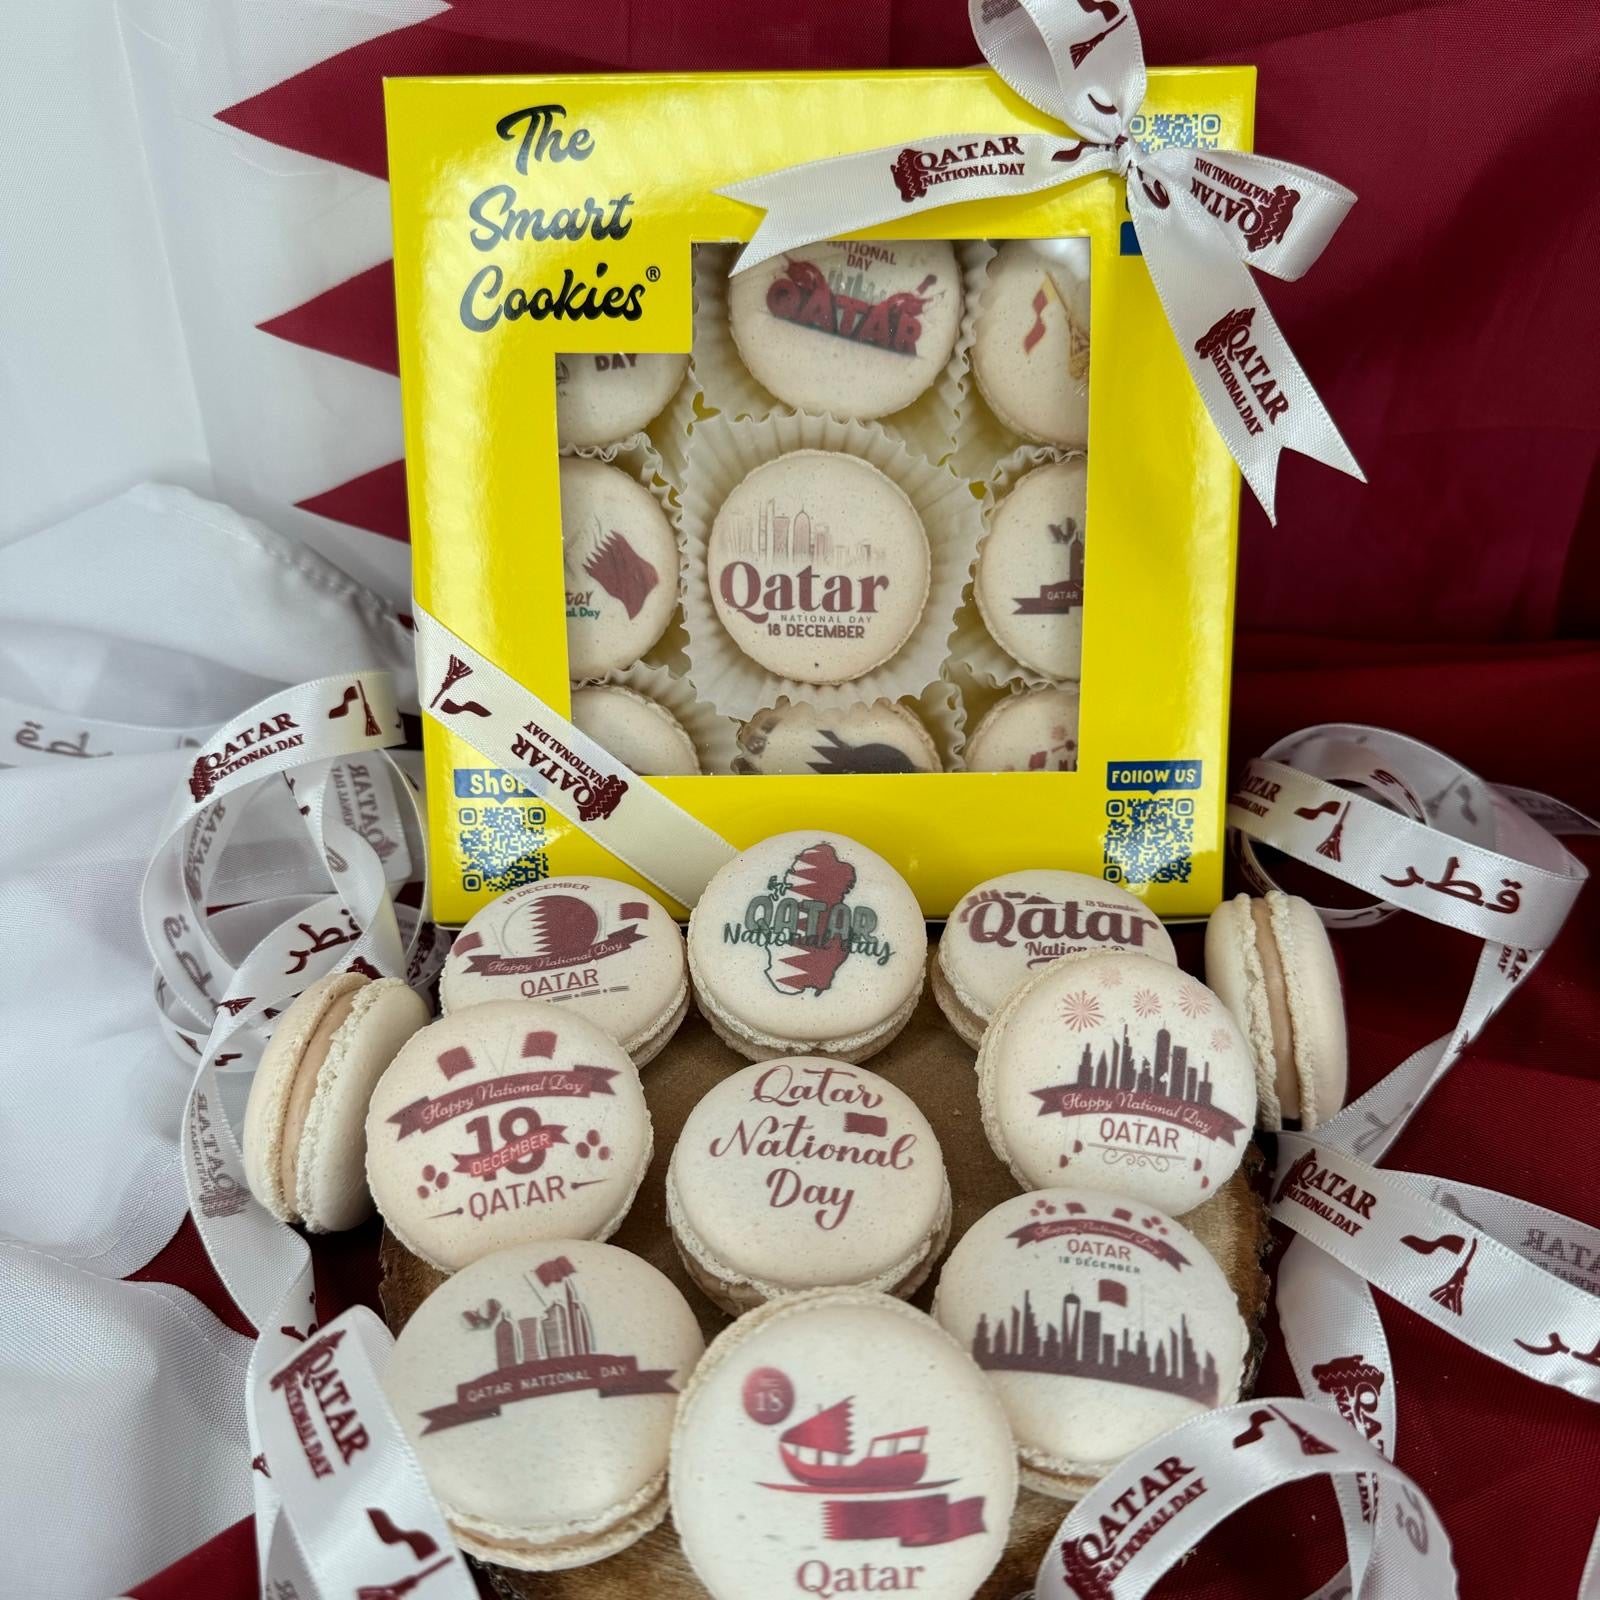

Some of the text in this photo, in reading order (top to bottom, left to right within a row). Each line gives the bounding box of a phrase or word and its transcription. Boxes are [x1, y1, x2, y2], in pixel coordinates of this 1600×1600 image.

[497, 104, 595, 176] The
[914, 136, 1025, 171] QATAR
[921, 162, 1025, 188] NATIONAL DAY
[1194, 157, 1274, 206] NATIONAL DAY
[469, 184, 634, 252] Smart
[1190, 177, 1261, 233] QATAR
[826, 241, 897, 265] NATIONAL
[847, 254, 872, 271] DAY
[594, 353, 637, 371] DAY
[1226, 325, 1289, 425] QATAR
[1210, 344, 1264, 437] NATIONAL DAY
[580, 607, 600, 620] Day
[719, 561, 889, 623] Qatar
[1047, 590, 1079, 601] QATAR
[768, 623, 865, 640] 18 DECEMBER
[781, 614, 872, 625] NATIONAL DAY
[207, 713, 300, 771] QATAR
[210, 733, 305, 787] NATIONAL DAY
[522, 720, 606, 788] NATIONAL DAY
[511, 733, 595, 807] QATAR
[1174, 768, 1197, 784] US
[516, 882, 591, 898] DECEMBER
[1380, 856, 1523, 915] قطر
[745, 896, 878, 943] QATAR
[968, 896, 1159, 948] Qatar
[488, 942, 623, 974] Happy National Day
[520, 968, 600, 998] QATAR
[420, 1073, 584, 1124] Happy National Day
[750, 1064, 883, 1108] Qatar
[1061, 1091, 1213, 1133] Happy National Day
[1099, 1117, 1180, 1150] QATAR
[465, 1106, 547, 1183] 18
[470, 1131, 551, 1176] DECEMBER
[709, 1115, 918, 1170] National
[468, 1175, 567, 1221] QATAR
[766, 1168, 854, 1230] Day
[1298, 1161, 1377, 1220] QATAR
[1331, 1213, 1363, 1237] DAY
[1067, 1239, 1132, 1261] QATAR
[1075, 1257, 1142, 1274] DECEMBER
[466, 1365, 628, 1402] QATAR NATIONAL DAY
[302, 1347, 370, 1466] QATAR
[1079, 1456, 1197, 1566] QATAR
[1169, 1477, 1209, 1514] DAY
[796, 1560, 925, 1599] Qatar
